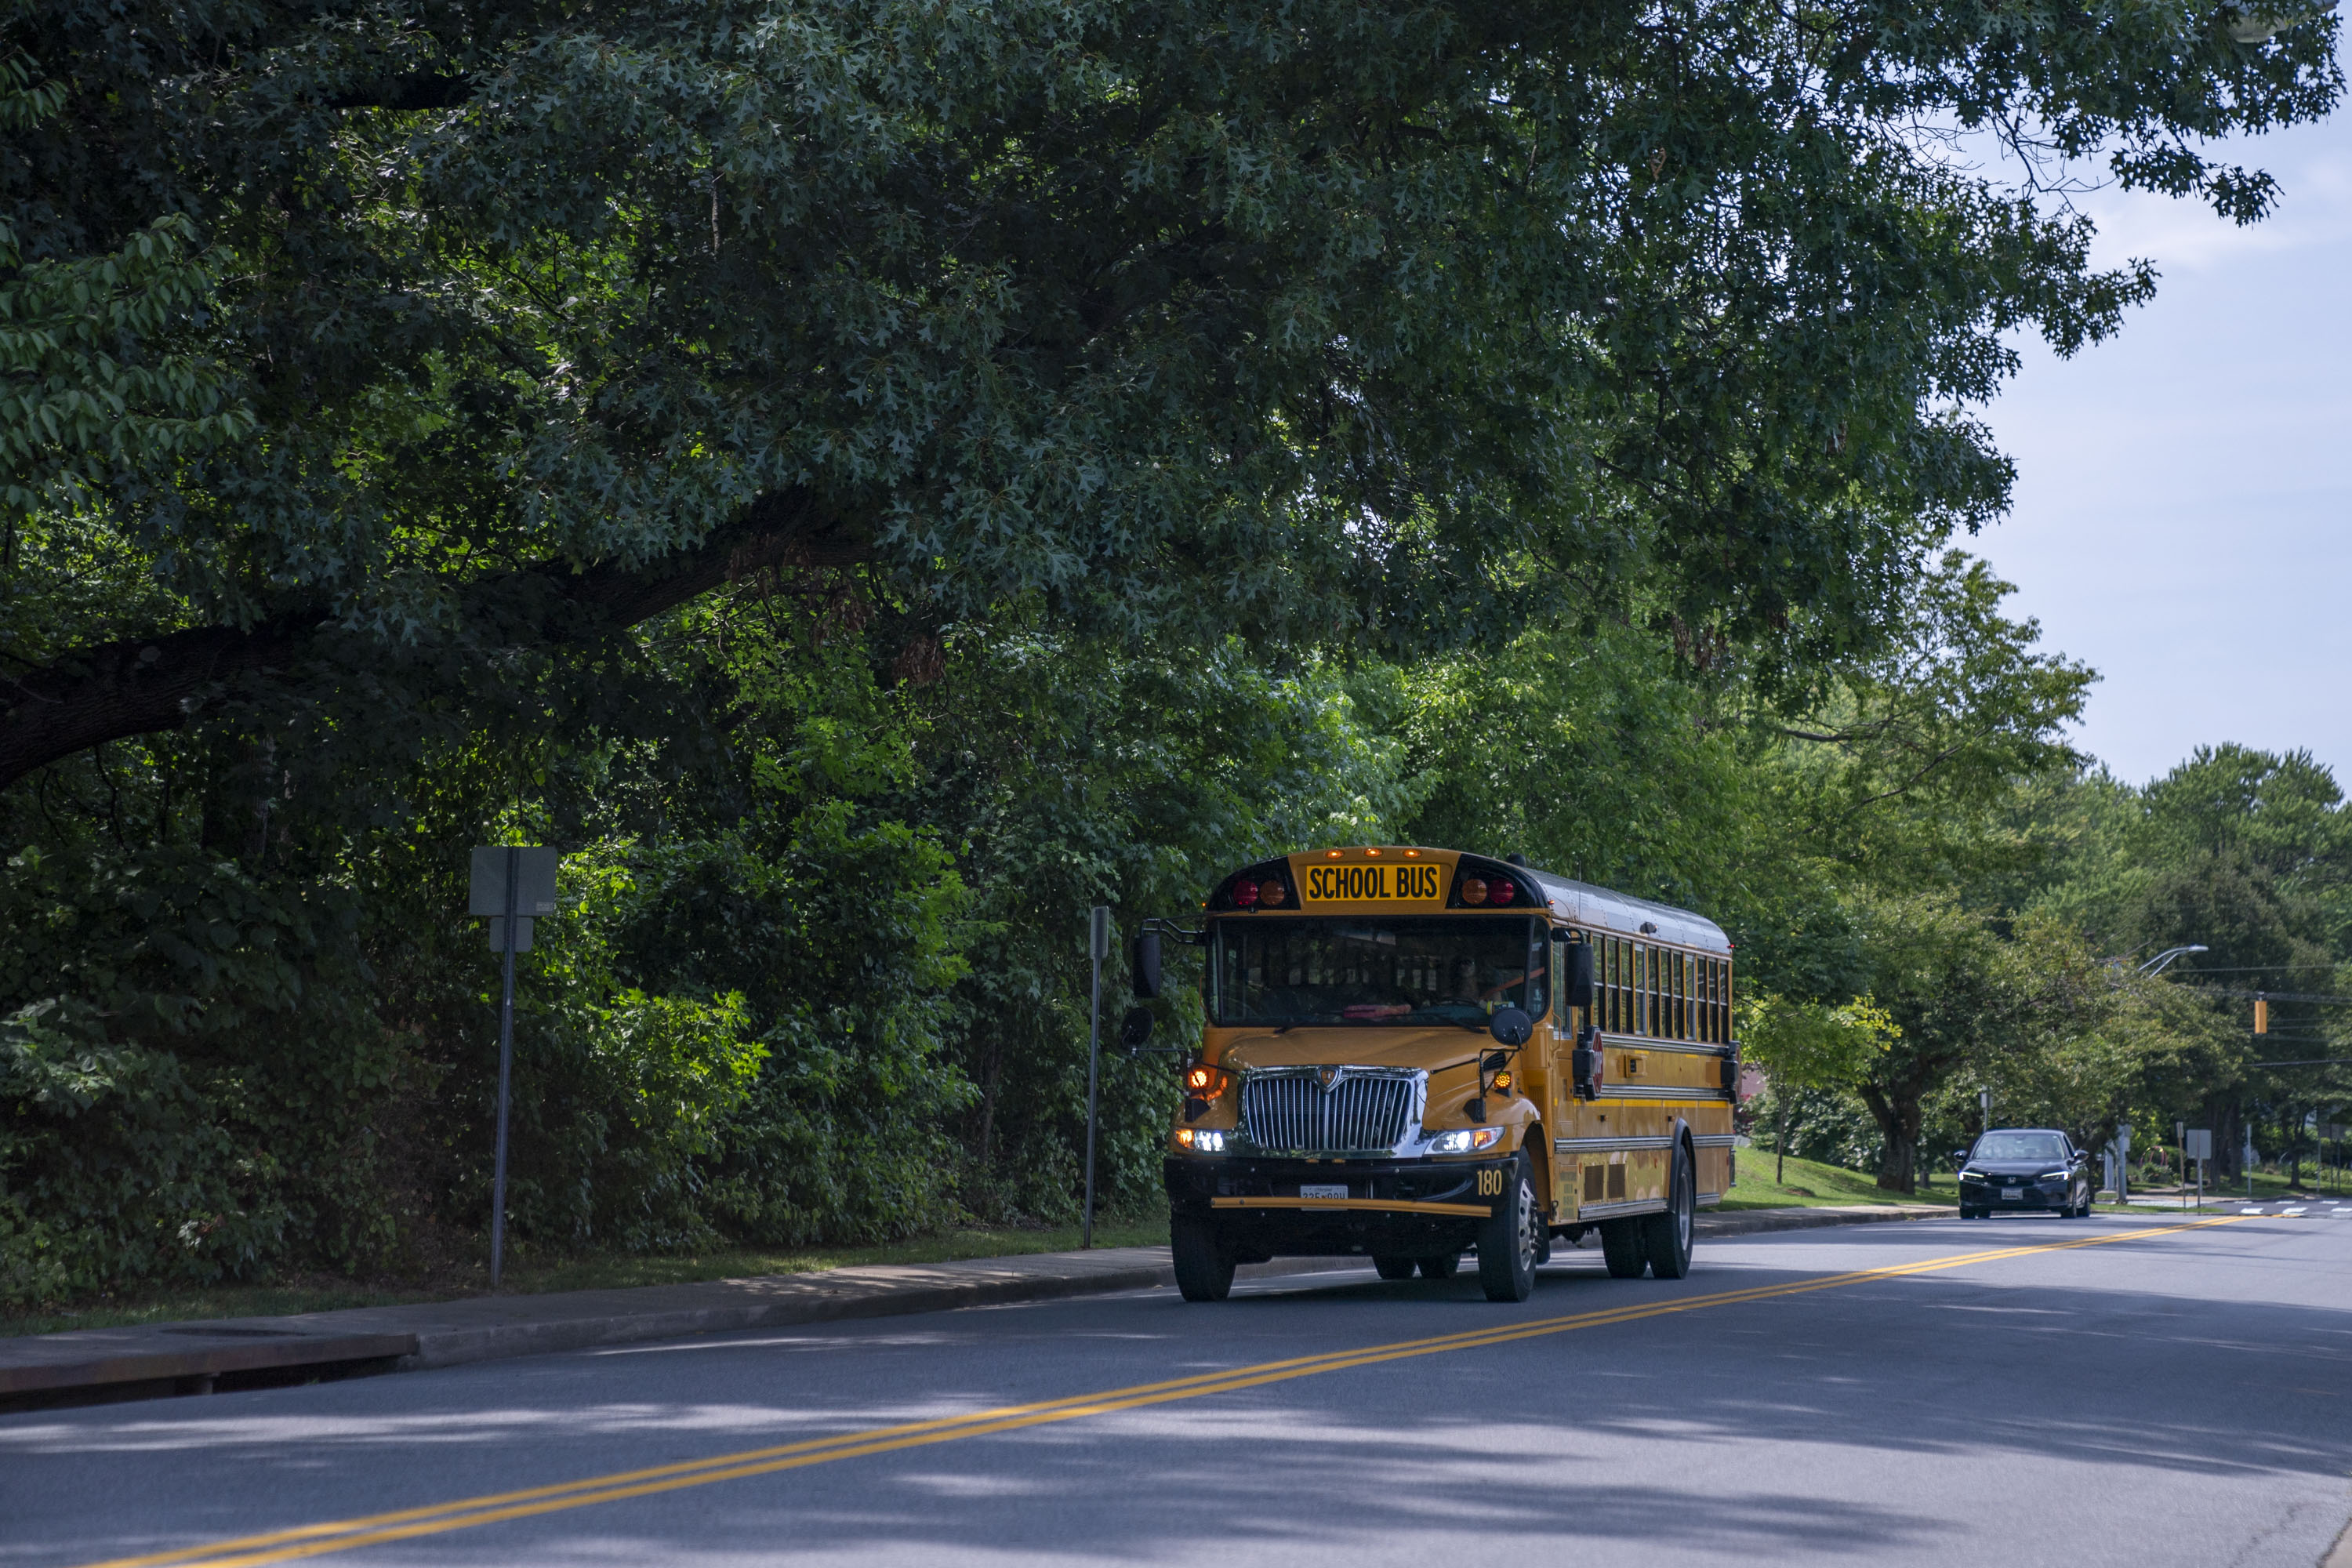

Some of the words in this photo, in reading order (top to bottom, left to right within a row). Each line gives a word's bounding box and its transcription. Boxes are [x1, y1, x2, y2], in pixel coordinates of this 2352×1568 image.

[1309, 867, 1391, 898] SCHOOL
[1396, 867, 1437, 898] BUS
[1476, 1169, 1502, 1196] 180
